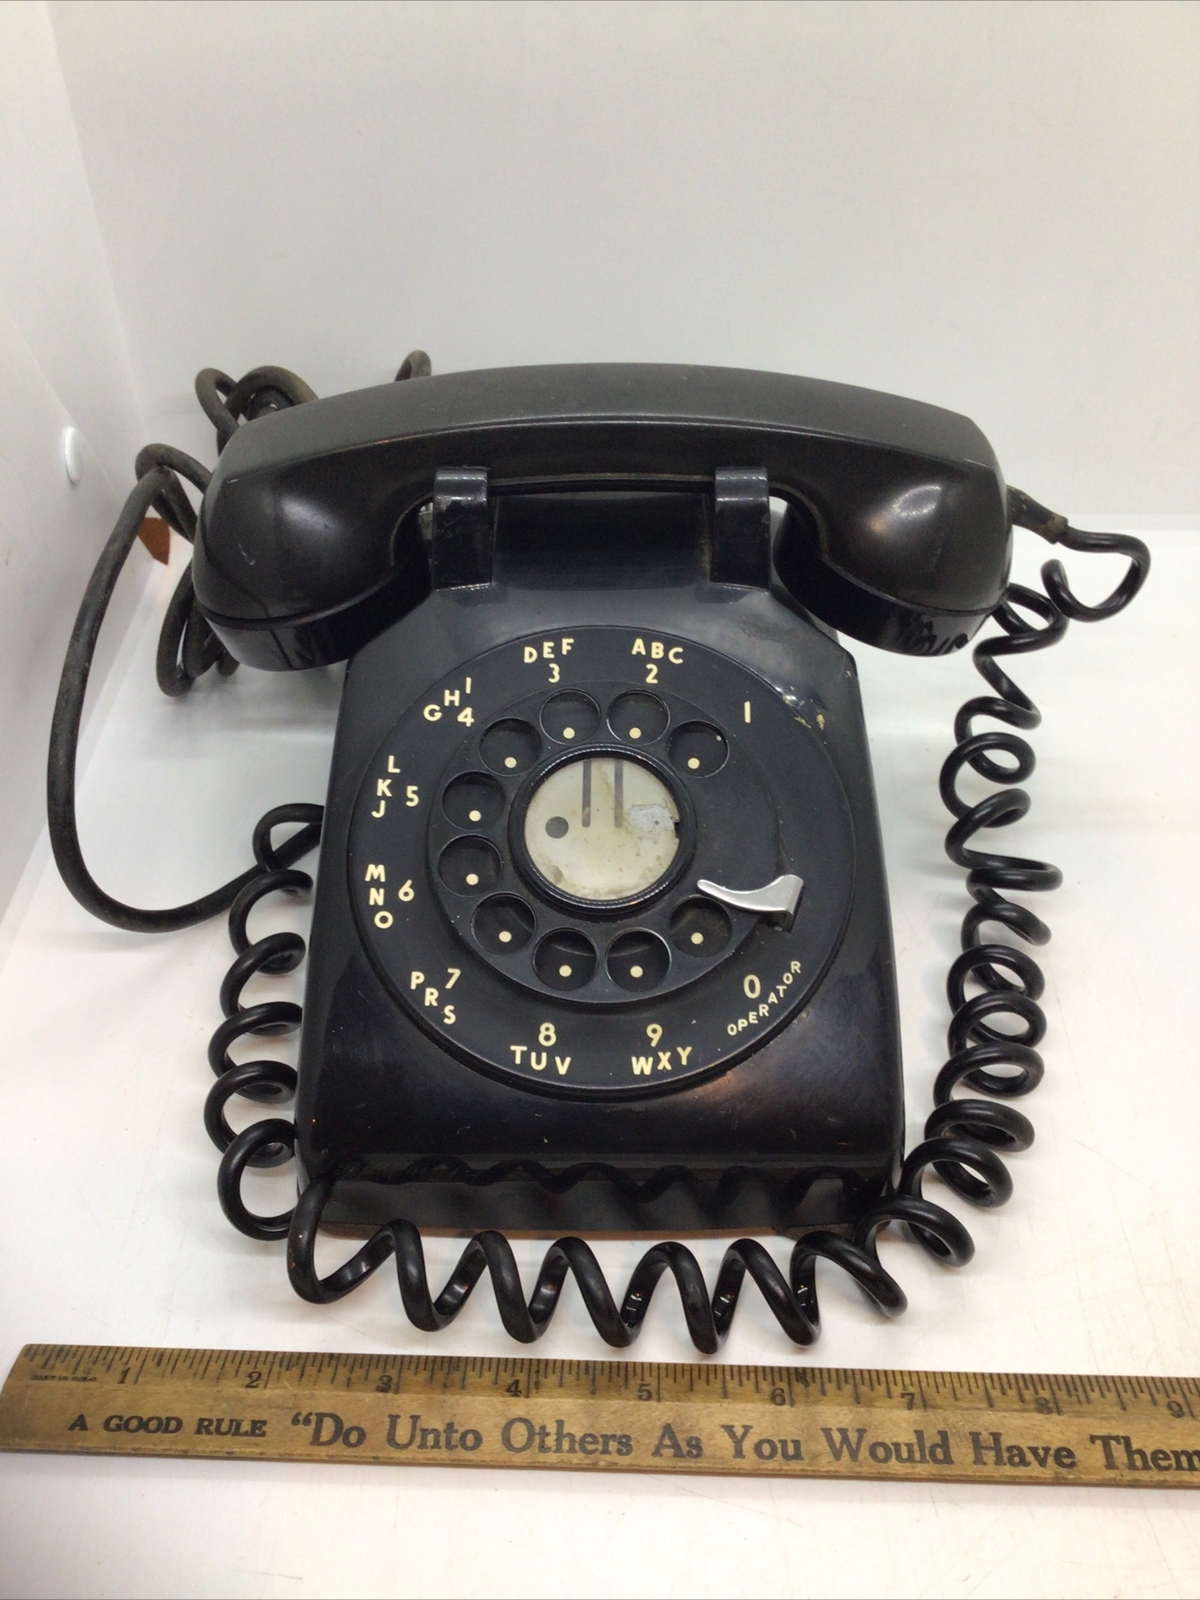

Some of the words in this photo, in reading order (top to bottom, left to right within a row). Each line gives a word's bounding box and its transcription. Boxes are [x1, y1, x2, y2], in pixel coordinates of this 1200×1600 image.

[523, 637, 575, 665] DEF
[631, 638, 684, 665] ABC
[548, 664, 562, 684] 3
[645, 665, 659, 684] 2
[456, 706, 476, 728] 4
[405, 785, 420, 807] 5
[397, 879, 415, 902] 6
[444, 967, 462, 990] 7
[727, 960, 802, 1037] OPERATOR
[538, 1022, 558, 1047] 8
[646, 1023, 664, 1048] 9
[510, 1045, 572, 1076] TUV
[631, 1046, 693, 1076] WXY
[116, 1367, 132, 1385] 1
[245, 1370, 263, 1389] 2
[376, 1375, 393, 1393] 3
[505, 1379, 523, 1398] 4
[637, 1384, 653, 1401] 5
[770, 1387, 786, 1407] 6
[901, 1392, 916, 1411] 7
[1035, 1397, 1052, 1415] 8
[1166, 1400, 1185, 1419] 9
[67, 1414, 89, 1432] A
[103, 1415, 184, 1434] GOOD
[194, 1417, 267, 1438] RULE
[385, 1414, 484, 1452] Unto
[501, 1417, 634, 1457] Others
[651, 1423, 703, 1460] As
[721, 1424, 803, 1462] You
[820, 1427, 954, 1466] Would
[968, 1431, 1077, 1470] Have
[1089, 1434, 1200, 1472] Them
